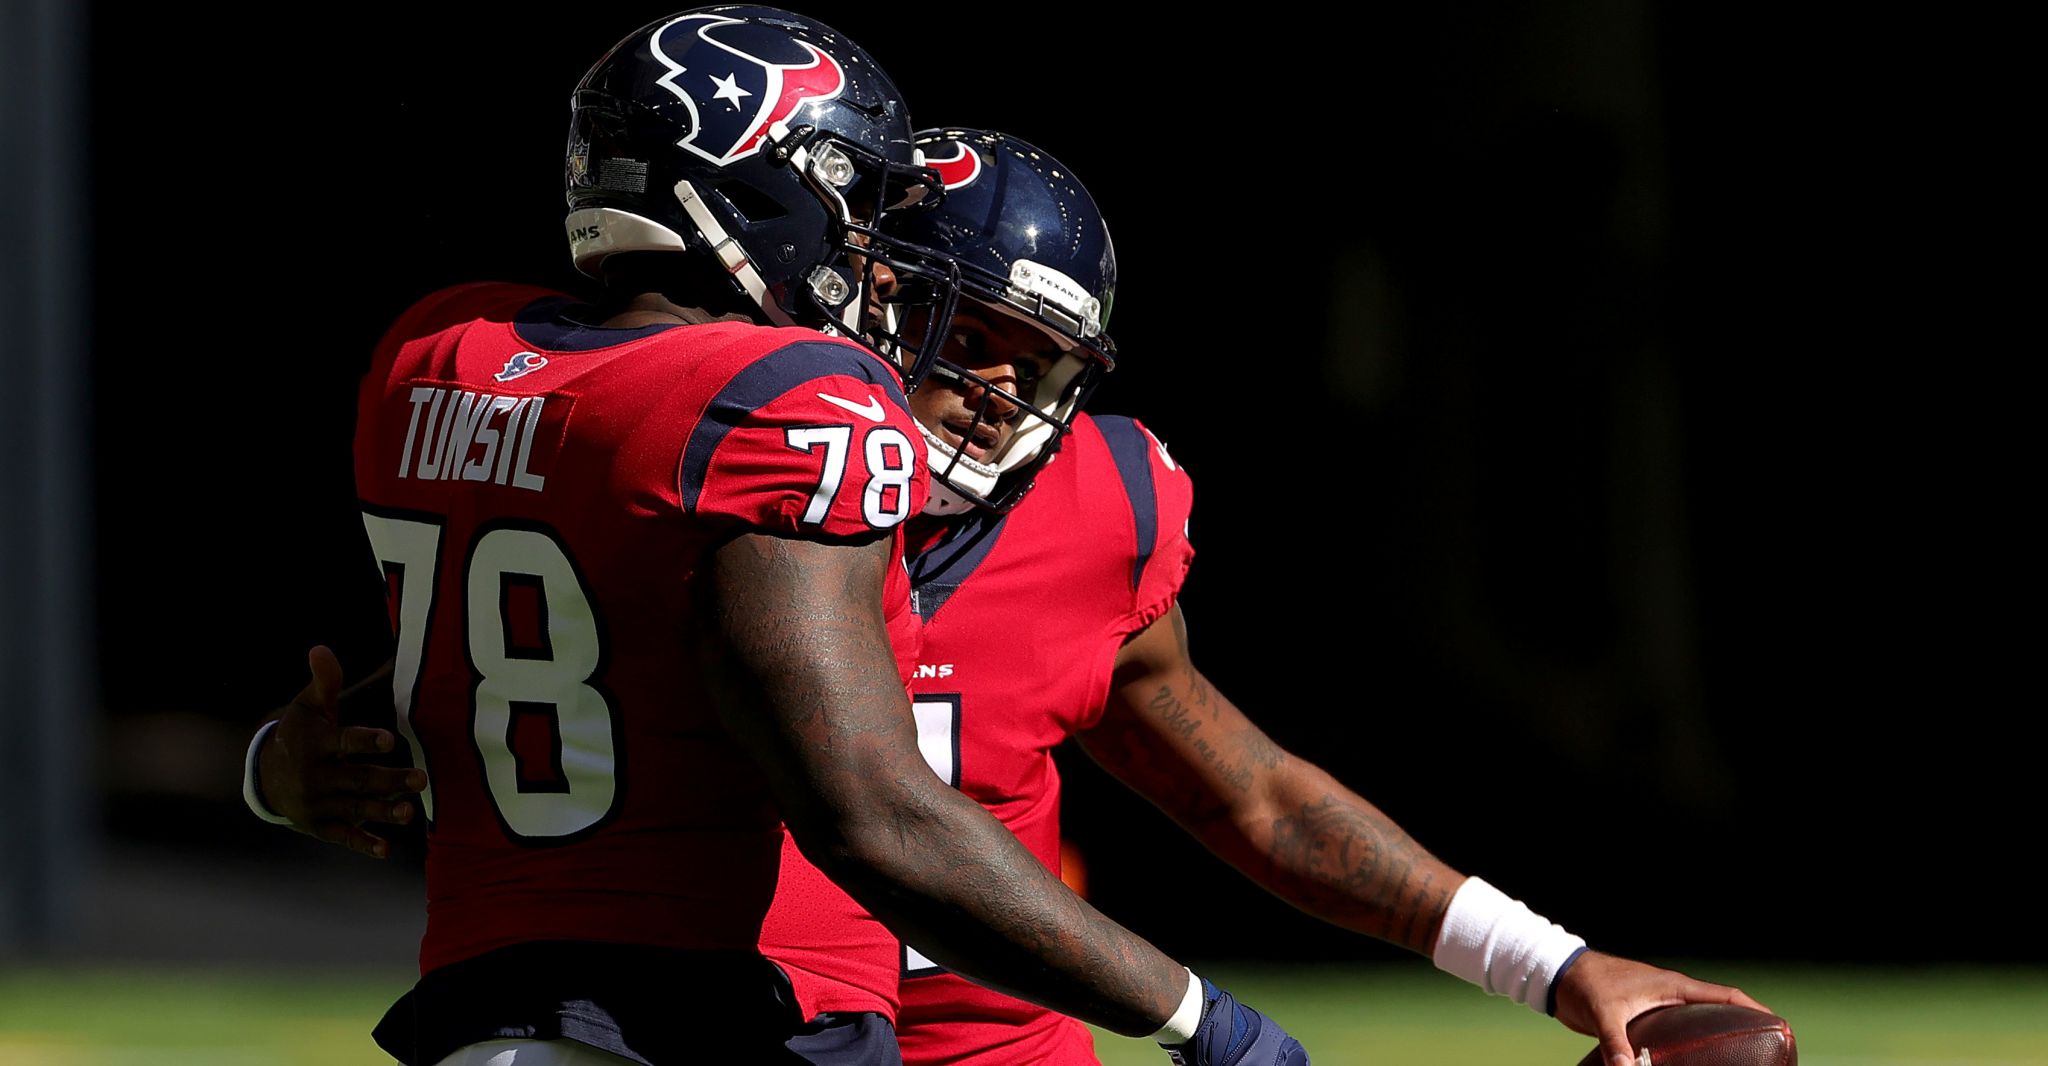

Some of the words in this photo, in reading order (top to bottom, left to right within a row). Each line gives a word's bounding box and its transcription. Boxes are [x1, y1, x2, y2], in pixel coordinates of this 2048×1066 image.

[1038, 275, 1081, 301] TEXANS
[398, 387, 545, 492] TUNSIL
[783, 424, 915, 531] 78
[360, 506, 619, 842] 78
